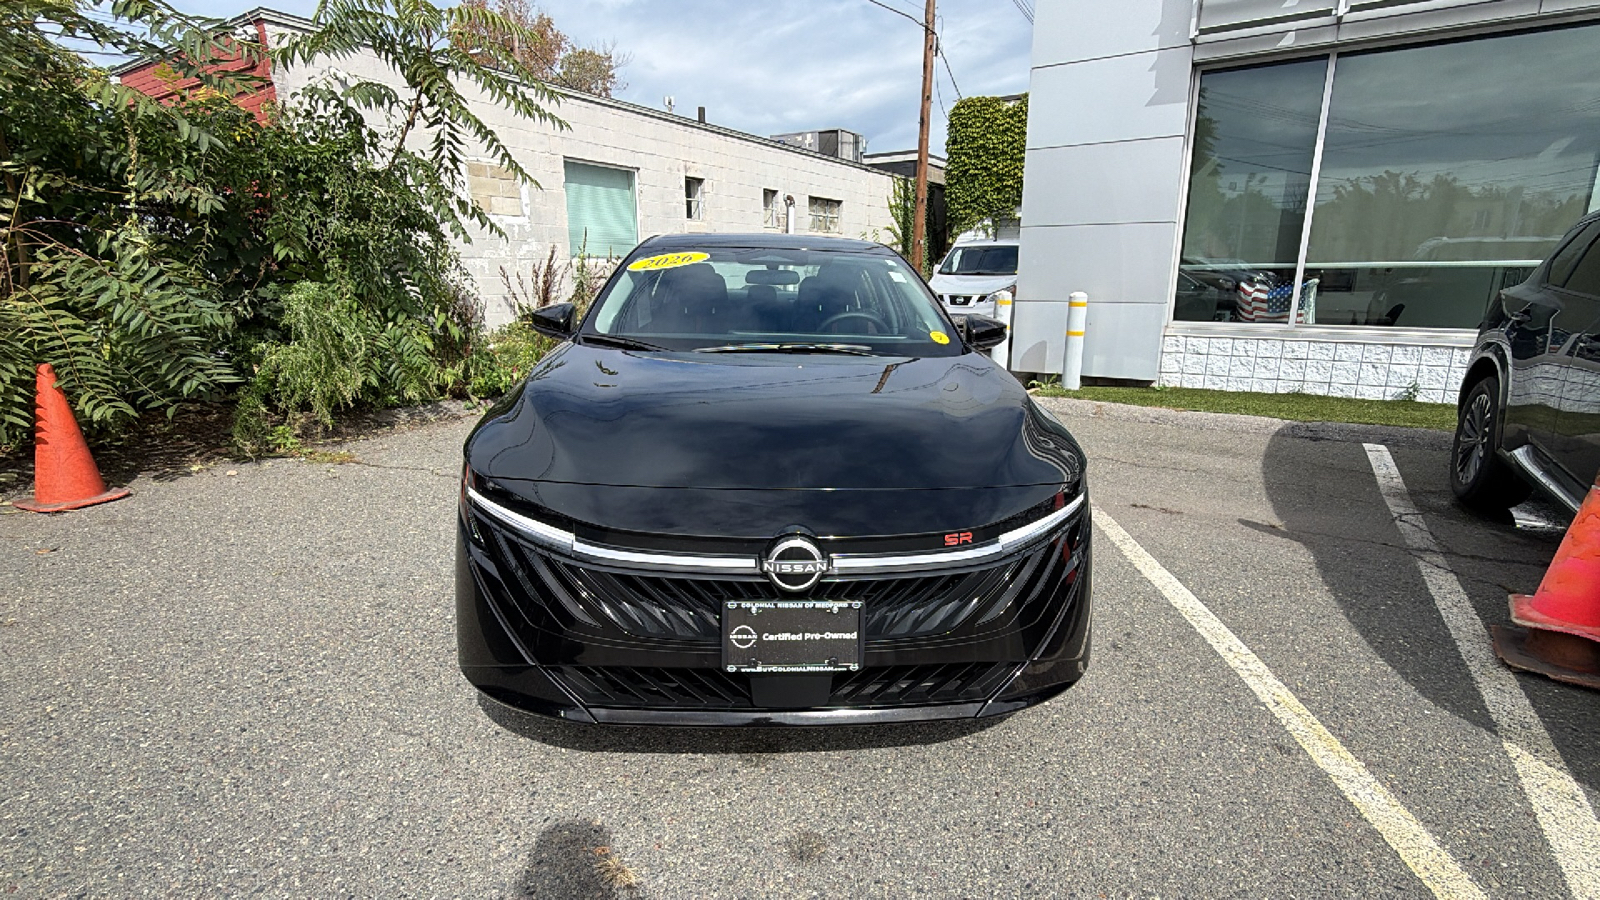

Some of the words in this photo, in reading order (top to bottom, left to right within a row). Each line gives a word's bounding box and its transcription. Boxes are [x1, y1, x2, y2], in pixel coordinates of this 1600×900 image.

[642, 254, 693, 269] 2026
[944, 531, 973, 546] SR
[763, 561, 827, 573] NISSAN
[762, 632, 803, 641] Certified
[804, 631, 858, 641] Pro-Owned
